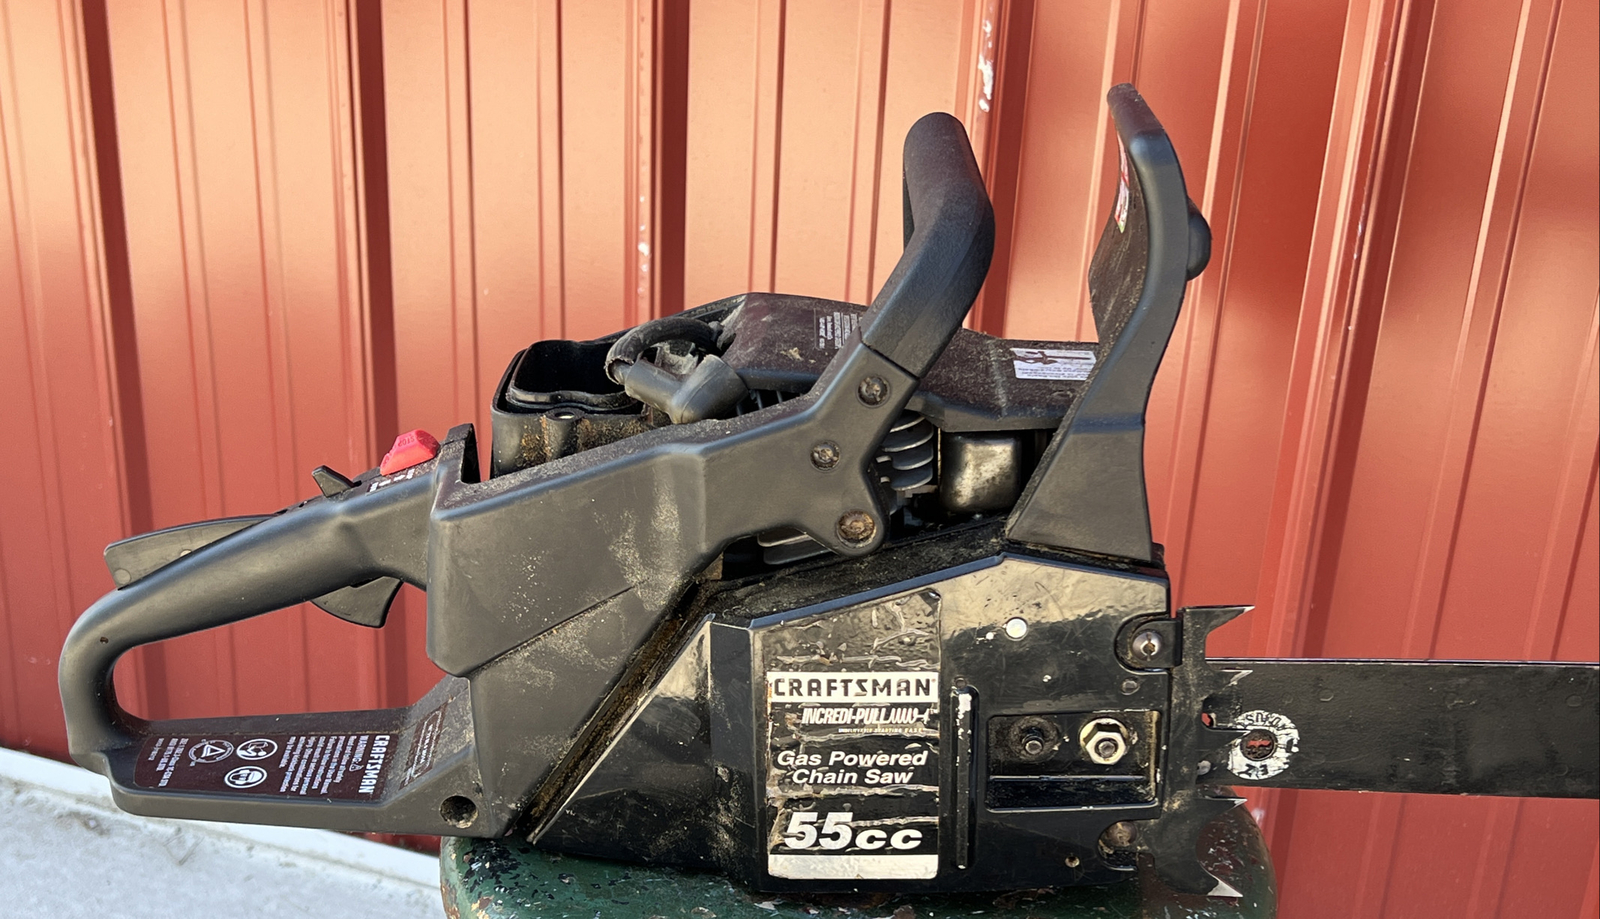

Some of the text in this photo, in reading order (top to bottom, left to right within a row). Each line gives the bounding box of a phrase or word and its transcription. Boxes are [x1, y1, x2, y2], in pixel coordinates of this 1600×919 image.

[774, 678, 931, 697] CRAFTSMAN
[358, 734, 390, 793] CRAFTSMAN
[777, 750, 929, 767] Gas Powered
[792, 769, 914, 785] Chain Saw
[784, 811, 923, 850] 55cc
